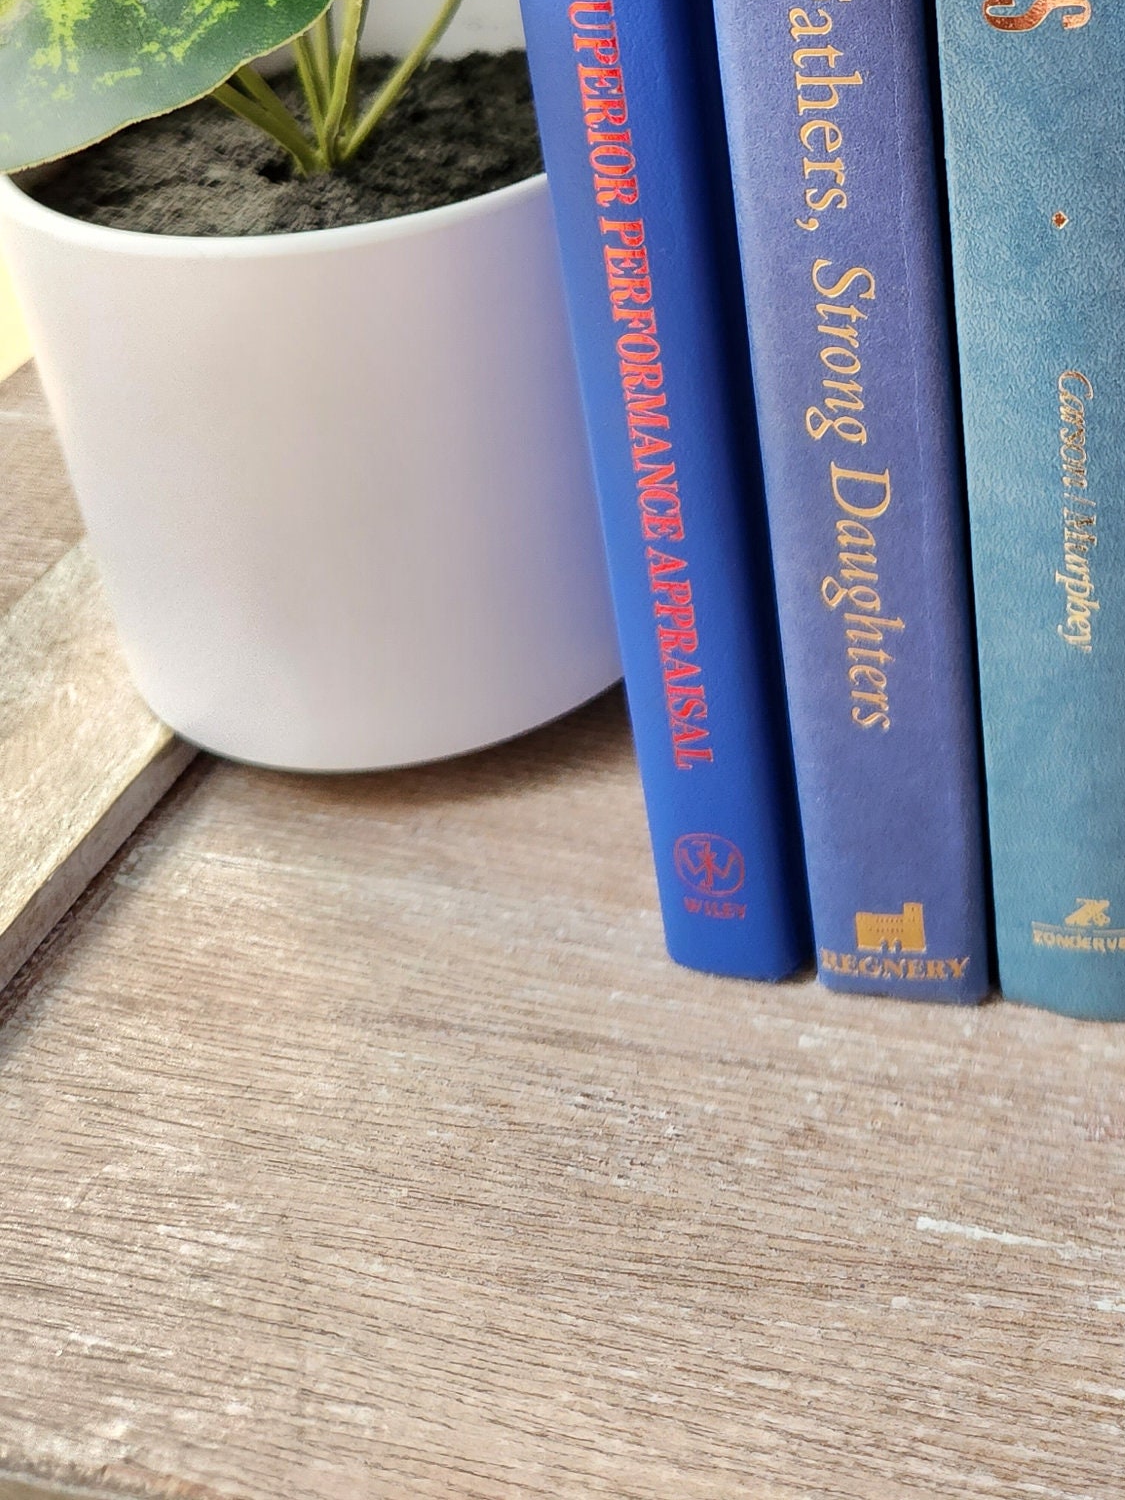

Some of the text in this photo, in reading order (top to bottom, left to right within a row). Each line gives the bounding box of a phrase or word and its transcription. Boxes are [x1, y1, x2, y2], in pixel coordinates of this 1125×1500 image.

[806, 258, 877, 447] Strong
[1057, 369, 1094, 489] Carson
[601, 216, 686, 542] PERFORMANCE
[646, 547, 714, 770] APPRAISAL
[820, 461, 906, 731] Daughters
[819, 946, 971, 981] REGNERY
